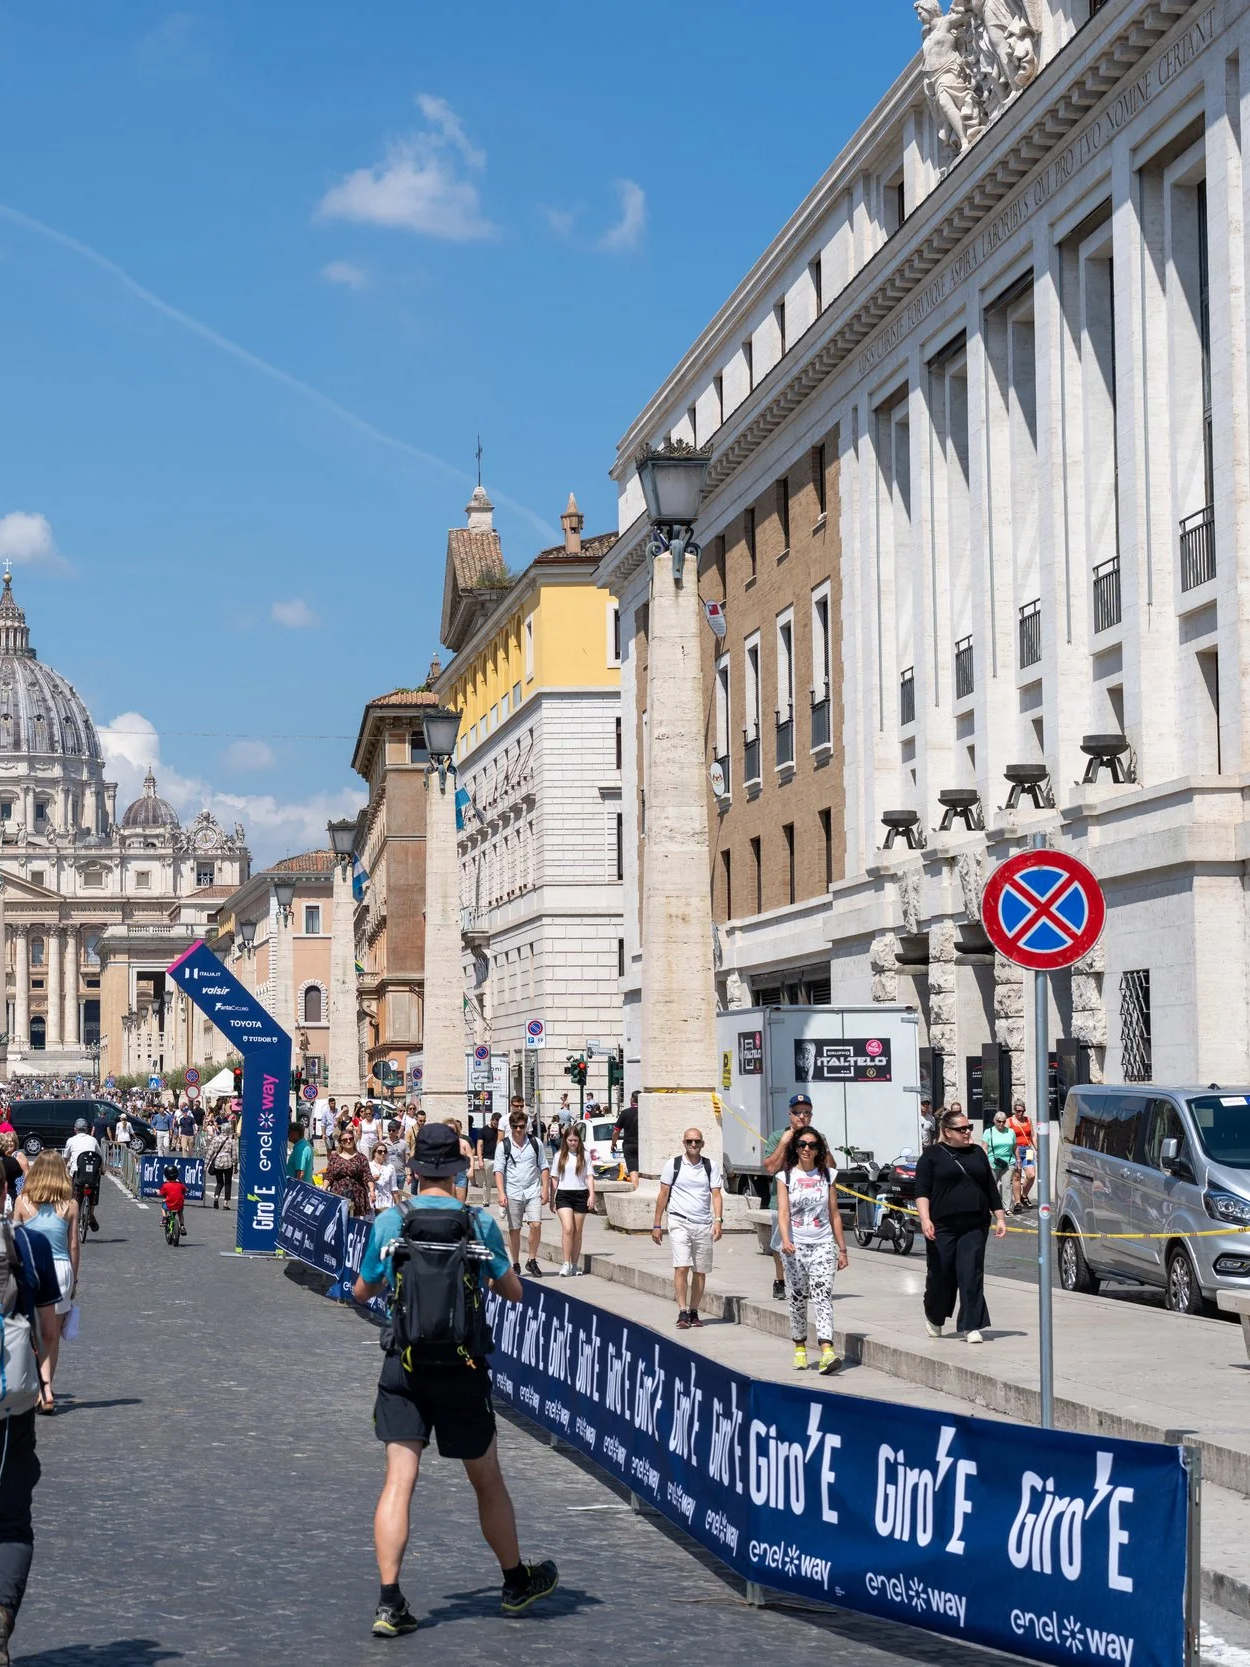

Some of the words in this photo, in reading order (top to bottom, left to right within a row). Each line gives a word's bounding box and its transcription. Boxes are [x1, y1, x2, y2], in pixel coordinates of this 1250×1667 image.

[877, 316, 904, 359] CHRISTE
[950, 246, 978, 287] ASPIRA
[982, 192, 1029, 258] LABORIBVS
[1033, 173, 1050, 206] QVI
[1054, 149, 1074, 188] PRO
[1078, 122, 1100, 163] TVO
[1106, 70, 1151, 138] NOMINE
[1158, 7, 1216, 85] CERTANT
[201, 986, 230, 995] valsir
[230, 1020, 262, 1028] TOYOTA
[262, 1073, 279, 1110] way
[257, 1131, 273, 1172] enel
[545, 1399, 558, 1419] enel
[561, 1407, 570, 1432] way
[603, 1435, 615, 1458] enel
[617, 1444, 627, 1472] way
[631, 1456, 644, 1481] enel
[649, 1467, 660, 1497] way
[667, 1480, 678, 1506] enel
[681, 1493, 696, 1526] way
[705, 1508, 721, 1537] enel
[725, 1523, 739, 1557] way
[749, 1539, 784, 1570] enel
[800, 1556, 831, 1591] way
[865, 1571, 907, 1604] enel
[927, 1587, 966, 1628] way
[1010, 1609, 1060, 1645] enel
[1086, 1628, 1134, 1667] way
